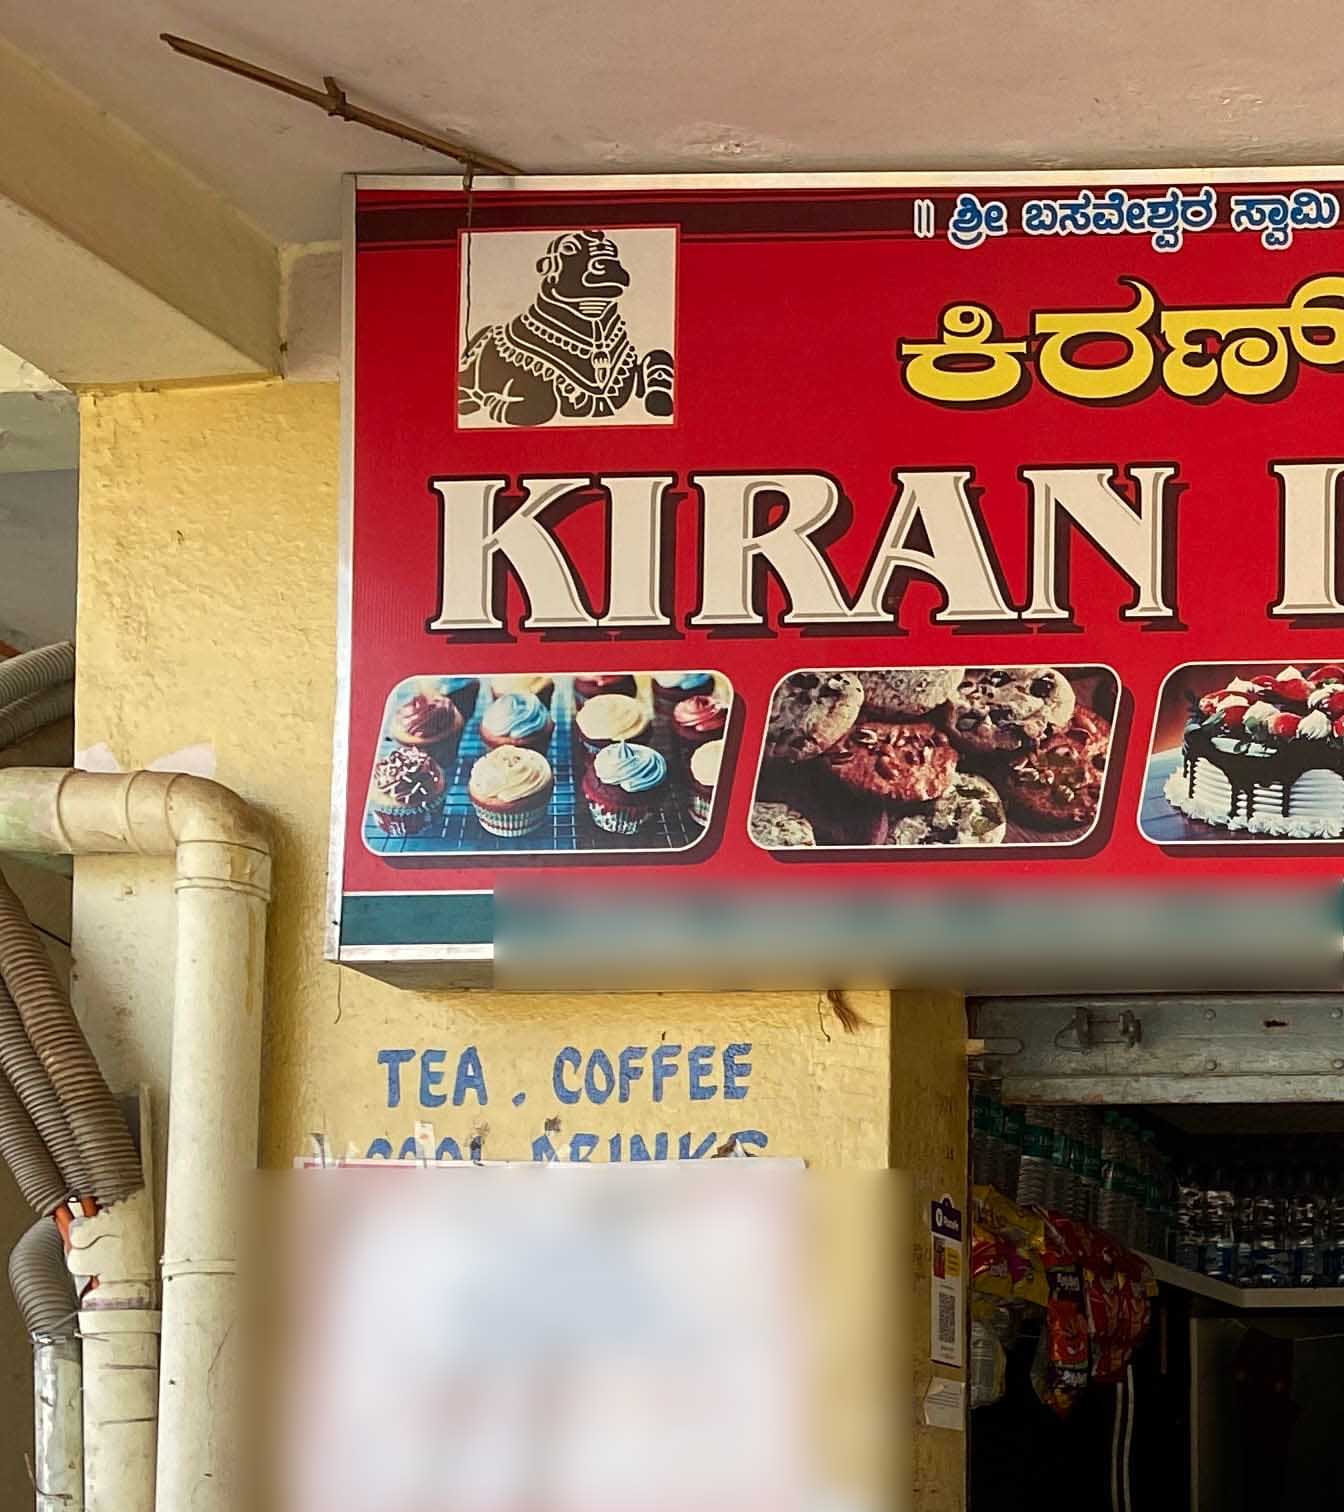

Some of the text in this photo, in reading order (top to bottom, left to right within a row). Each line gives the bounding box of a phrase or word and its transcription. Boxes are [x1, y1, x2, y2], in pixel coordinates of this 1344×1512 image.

[949, 193, 1008, 249] ಶ್ರೀ
[1023, 186, 1216, 252] ಬಸವೇಶ್ವರ
[1231, 188, 1339, 250] ಸ್ವಾಮಿ
[429, 467, 1177, 629] KIRAN
[376, 1045, 488, 1108] TEA
[552, 1043, 752, 1105] COFFEE
